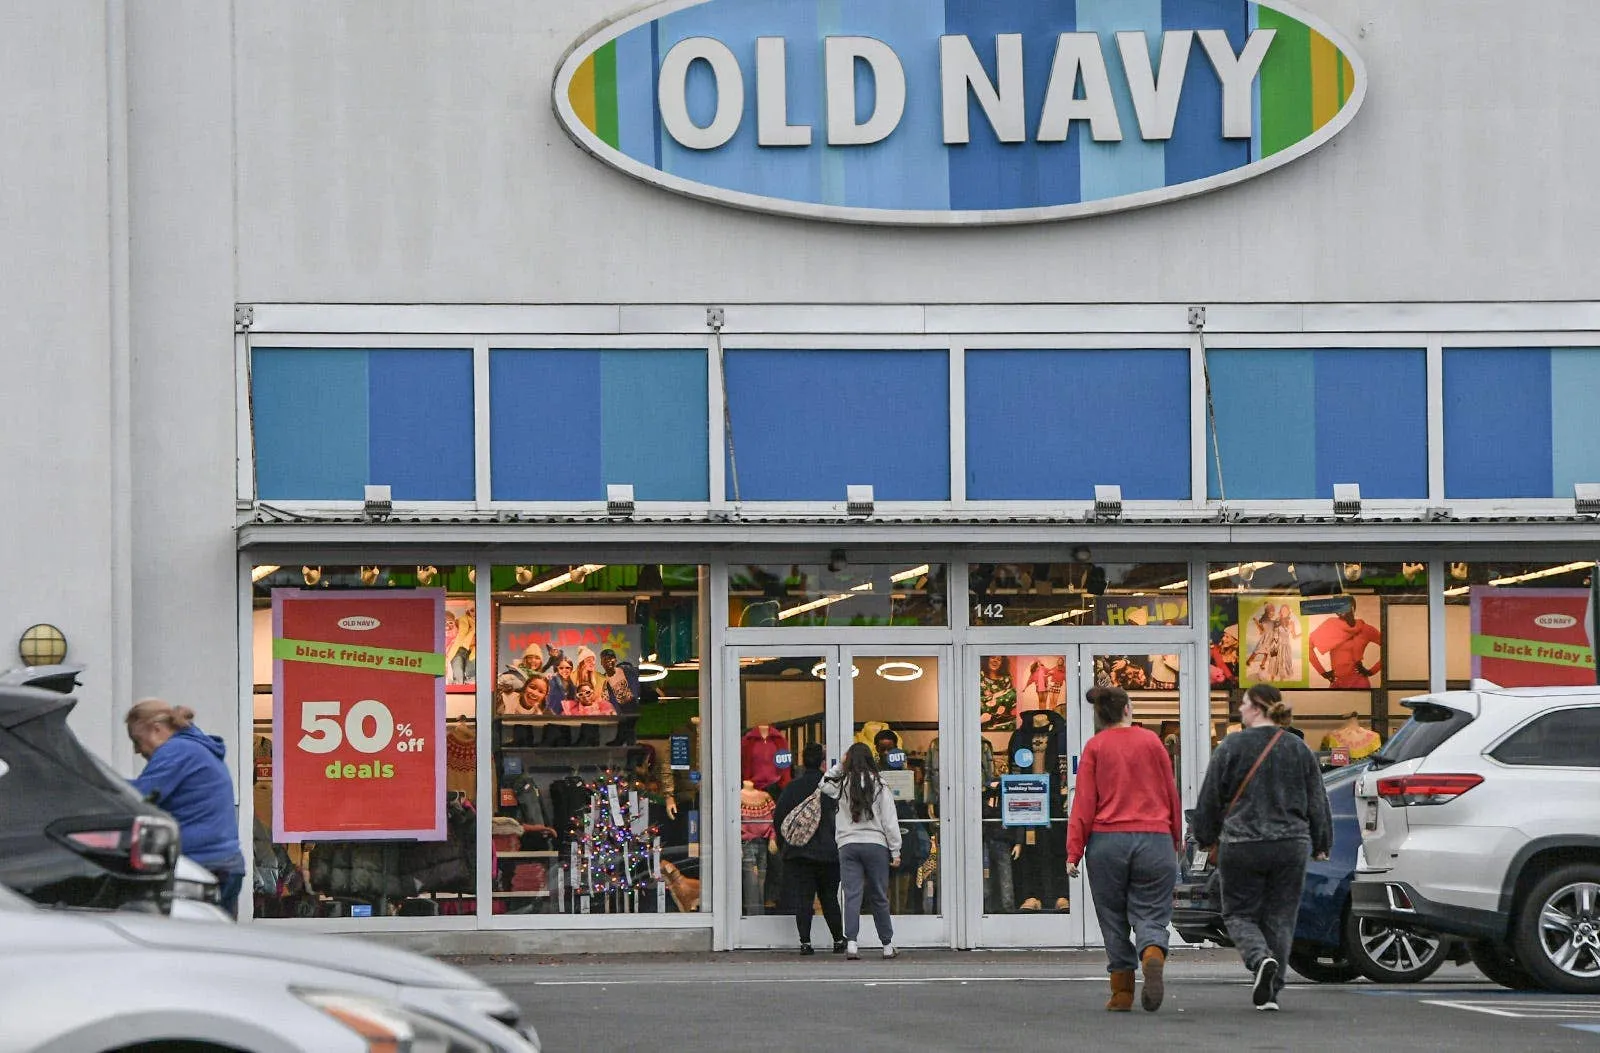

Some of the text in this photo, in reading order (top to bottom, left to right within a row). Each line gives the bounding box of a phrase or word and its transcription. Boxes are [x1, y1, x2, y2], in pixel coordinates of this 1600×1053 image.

[658, 28, 1277, 150] OLD NAVY
[974, 604, 1003, 618] 142
[508, 626, 611, 652] HOLIDAY
[295, 645, 422, 668] black friday sale!
[1493, 642, 1533, 657] black
[1537, 646, 1580, 663] friday
[396, 737, 425, 753] off
[775, 753, 792, 764] OUT
[888, 753, 905, 763] OUT
[325, 760, 395, 779] deals
